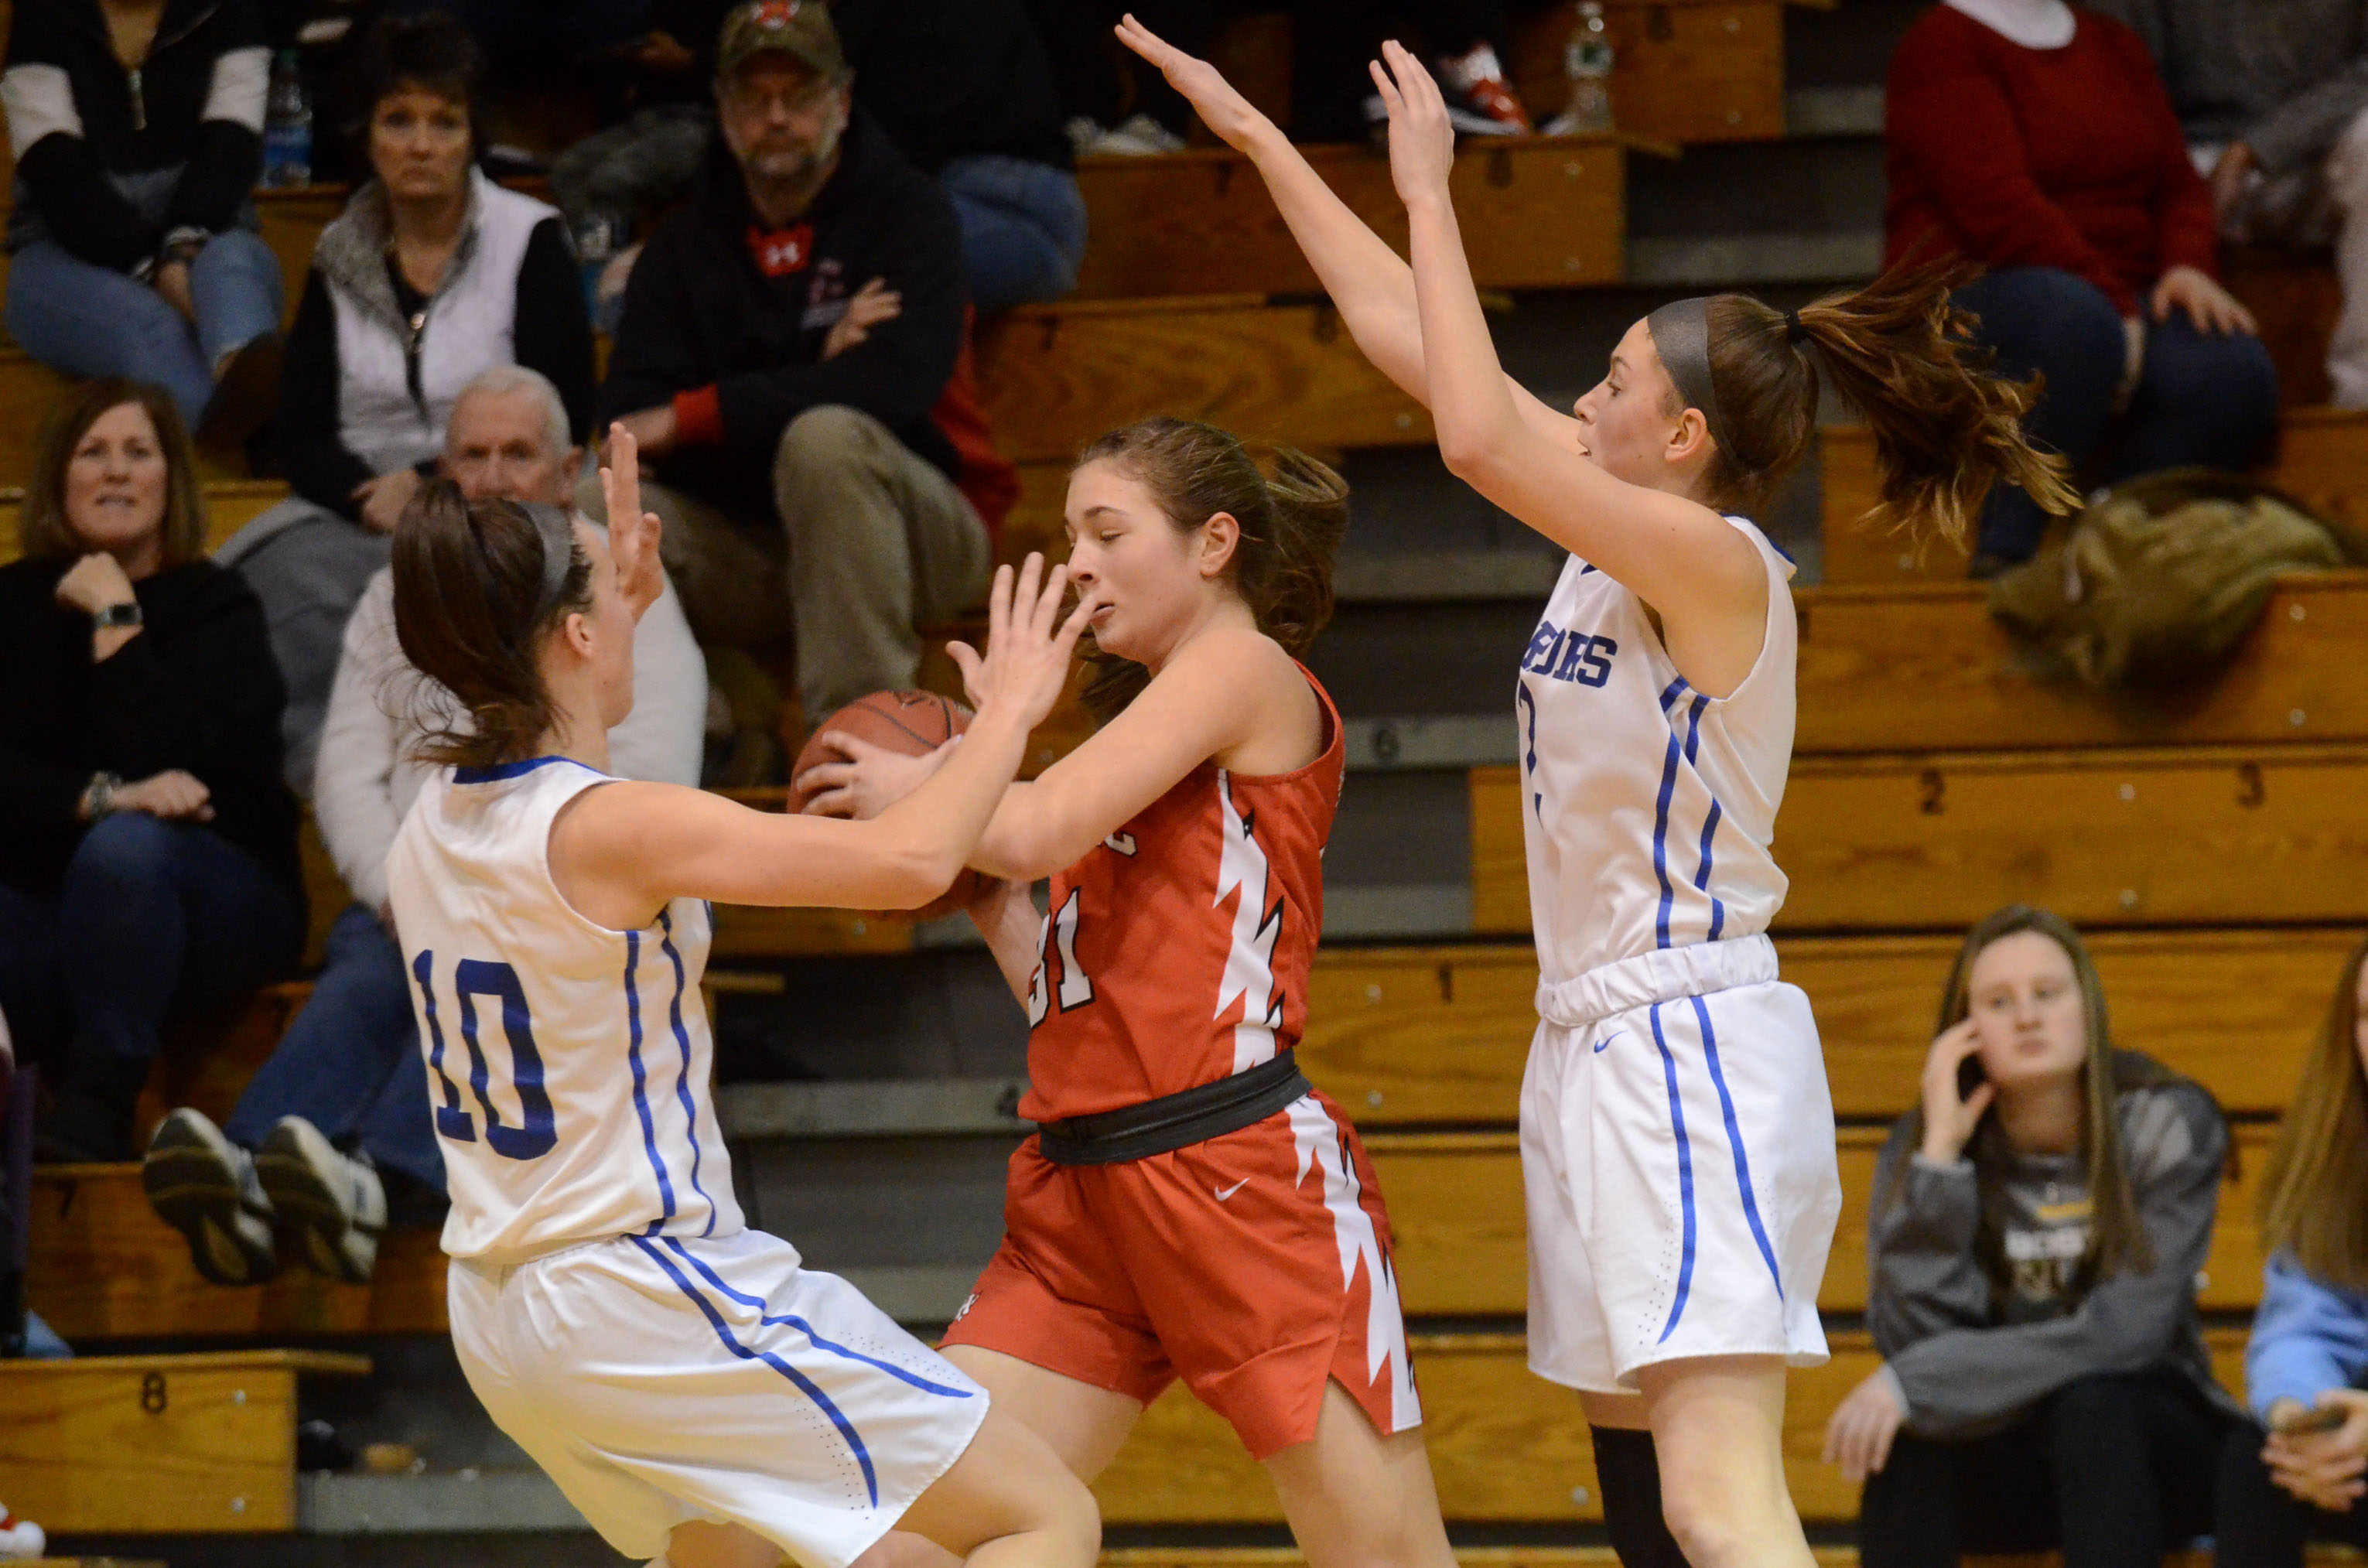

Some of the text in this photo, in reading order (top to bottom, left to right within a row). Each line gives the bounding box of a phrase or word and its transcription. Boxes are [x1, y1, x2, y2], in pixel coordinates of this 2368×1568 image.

[1920, 768, 1947, 816] 2
[2237, 761, 2264, 810] 3
[412, 949, 559, 1160] 10
[141, 1369, 167, 1416] 8
